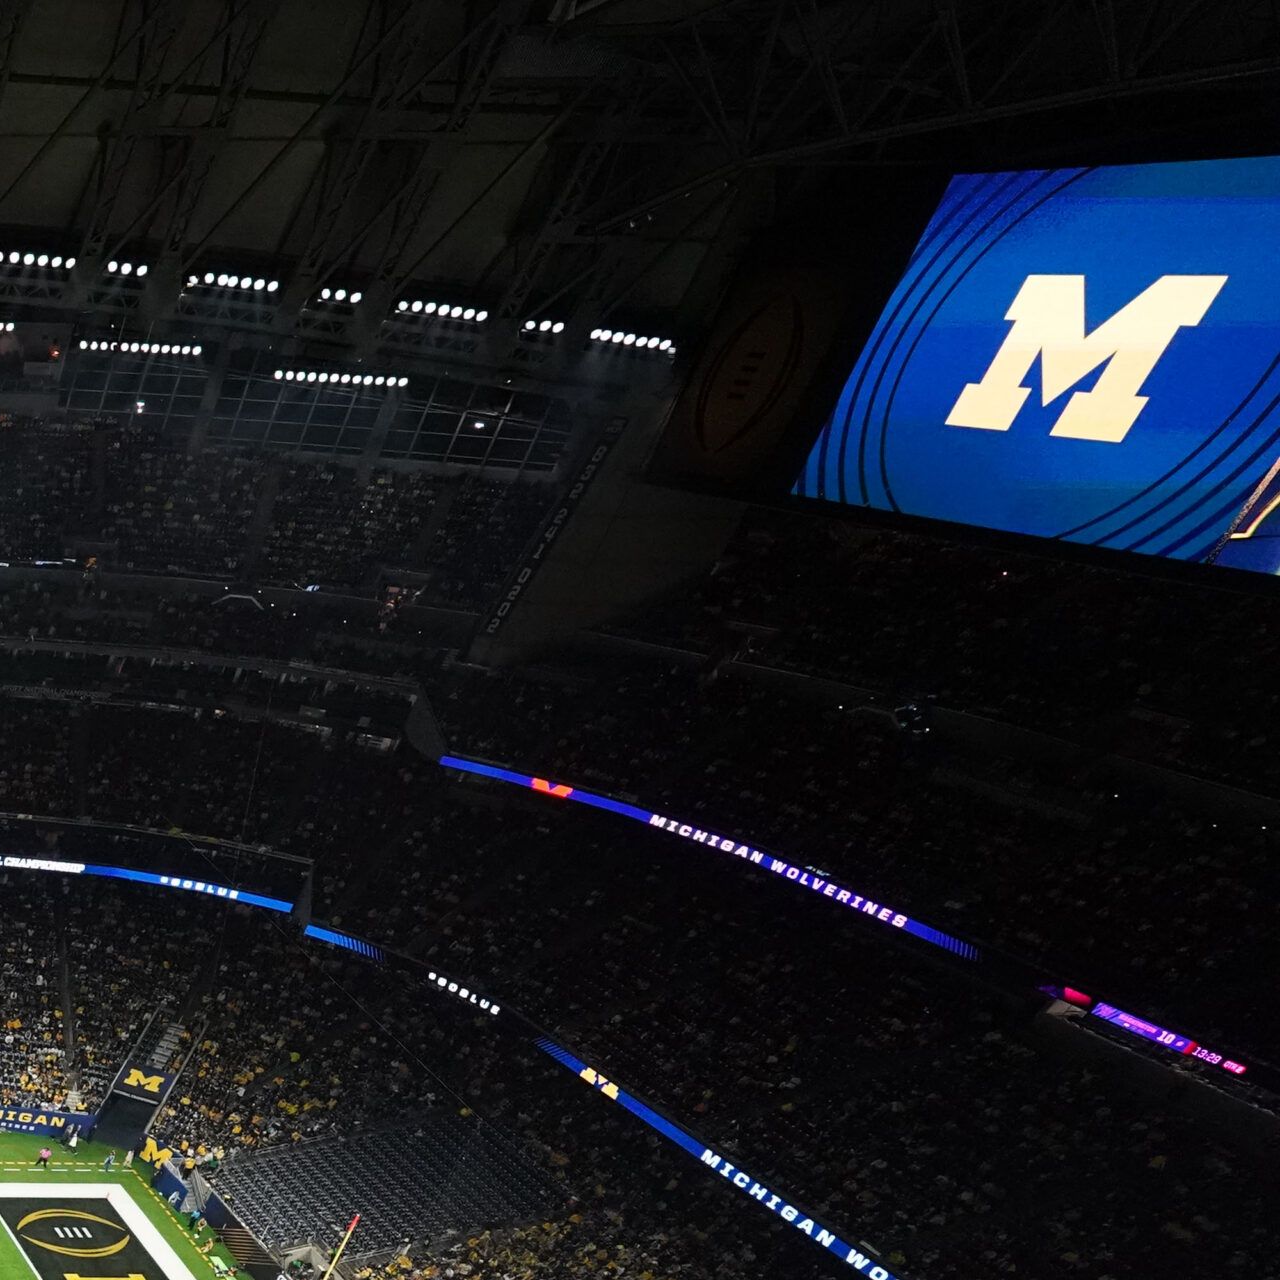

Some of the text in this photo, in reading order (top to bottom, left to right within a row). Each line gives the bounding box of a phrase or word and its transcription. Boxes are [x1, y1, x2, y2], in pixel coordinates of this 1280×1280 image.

[943, 274, 1228, 443] M
[3, 856, 85, 874] CHAMPIONSHIP
[647, 813, 909, 929] MICHIGAN WOLVERINES
[1156, 1030, 1176, 1045] 10
[1191, 1046, 1222, 1065] 13:29
[123, 1067, 165, 1093] M
[700, 1147, 836, 1249] MICHIGAN
